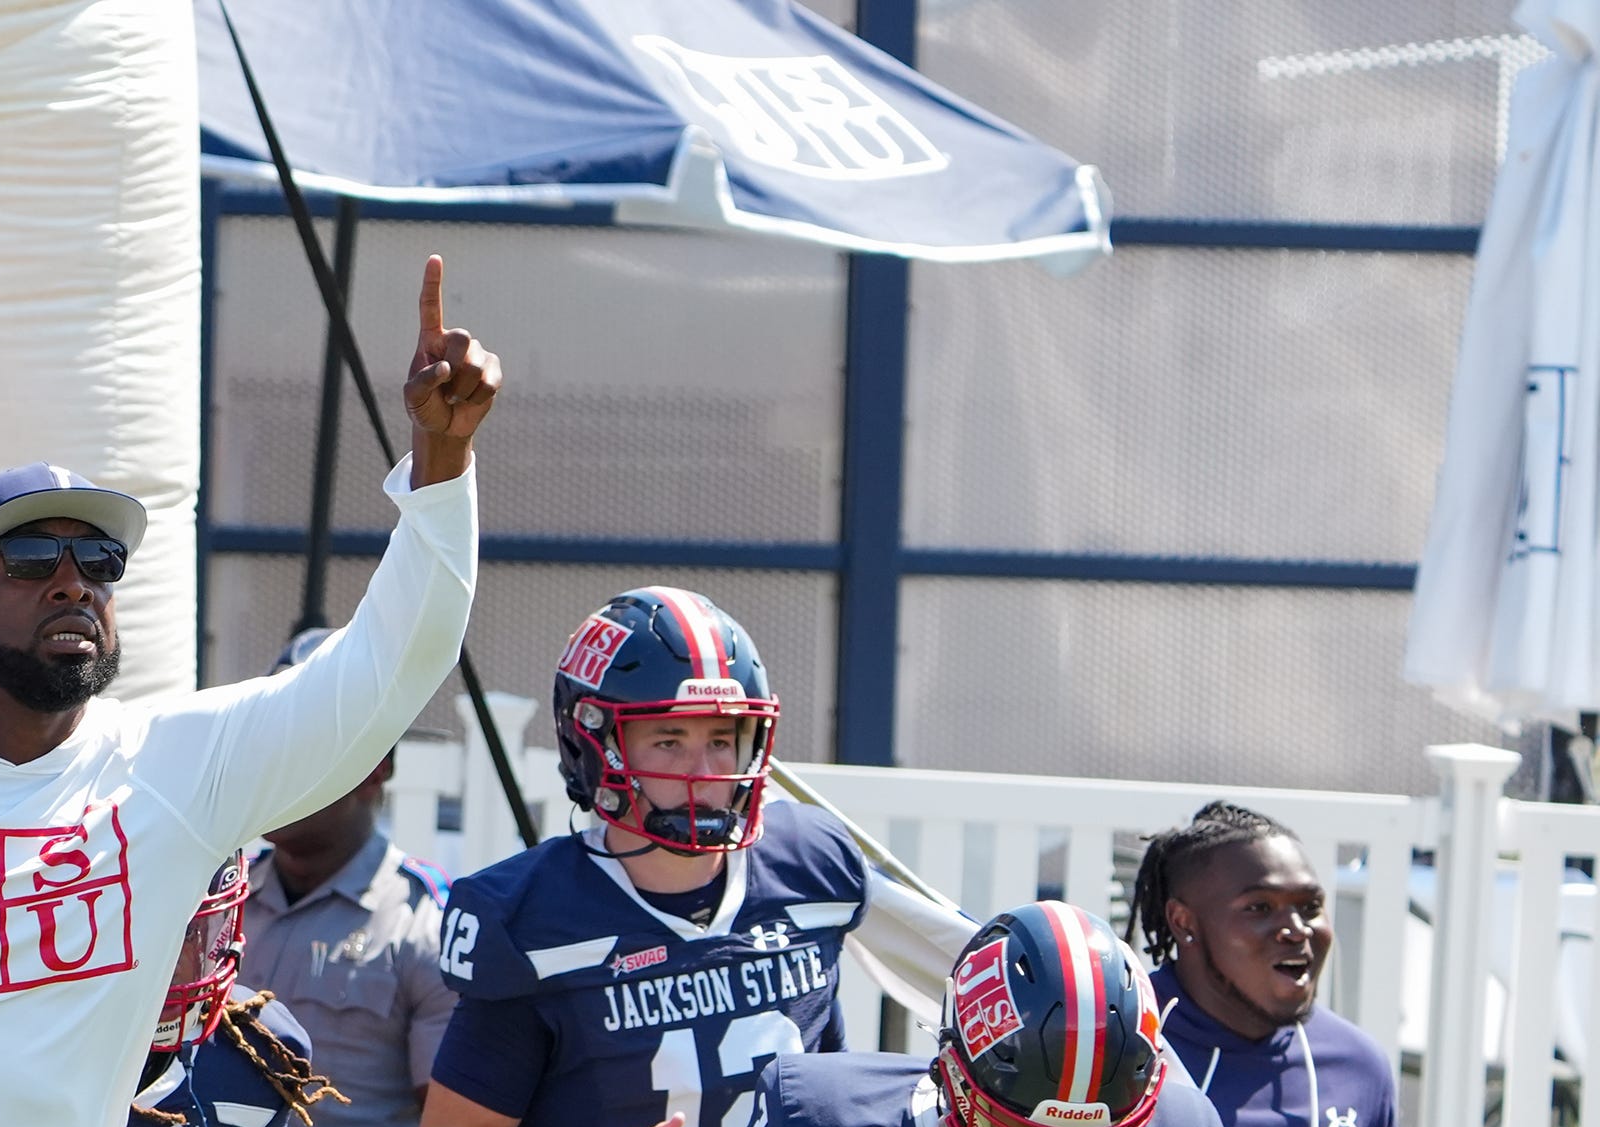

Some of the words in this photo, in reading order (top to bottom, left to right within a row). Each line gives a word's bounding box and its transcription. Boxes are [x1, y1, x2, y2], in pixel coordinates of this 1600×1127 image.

[687, 684, 738, 697] Riddell
[440, 907, 481, 982] 12
[625, 946, 668, 972] SWAC
[604, 966, 735, 1032] JACKSON
[741, 945, 827, 1007] STATE
[1045, 1106, 1104, 1121] Riddell
